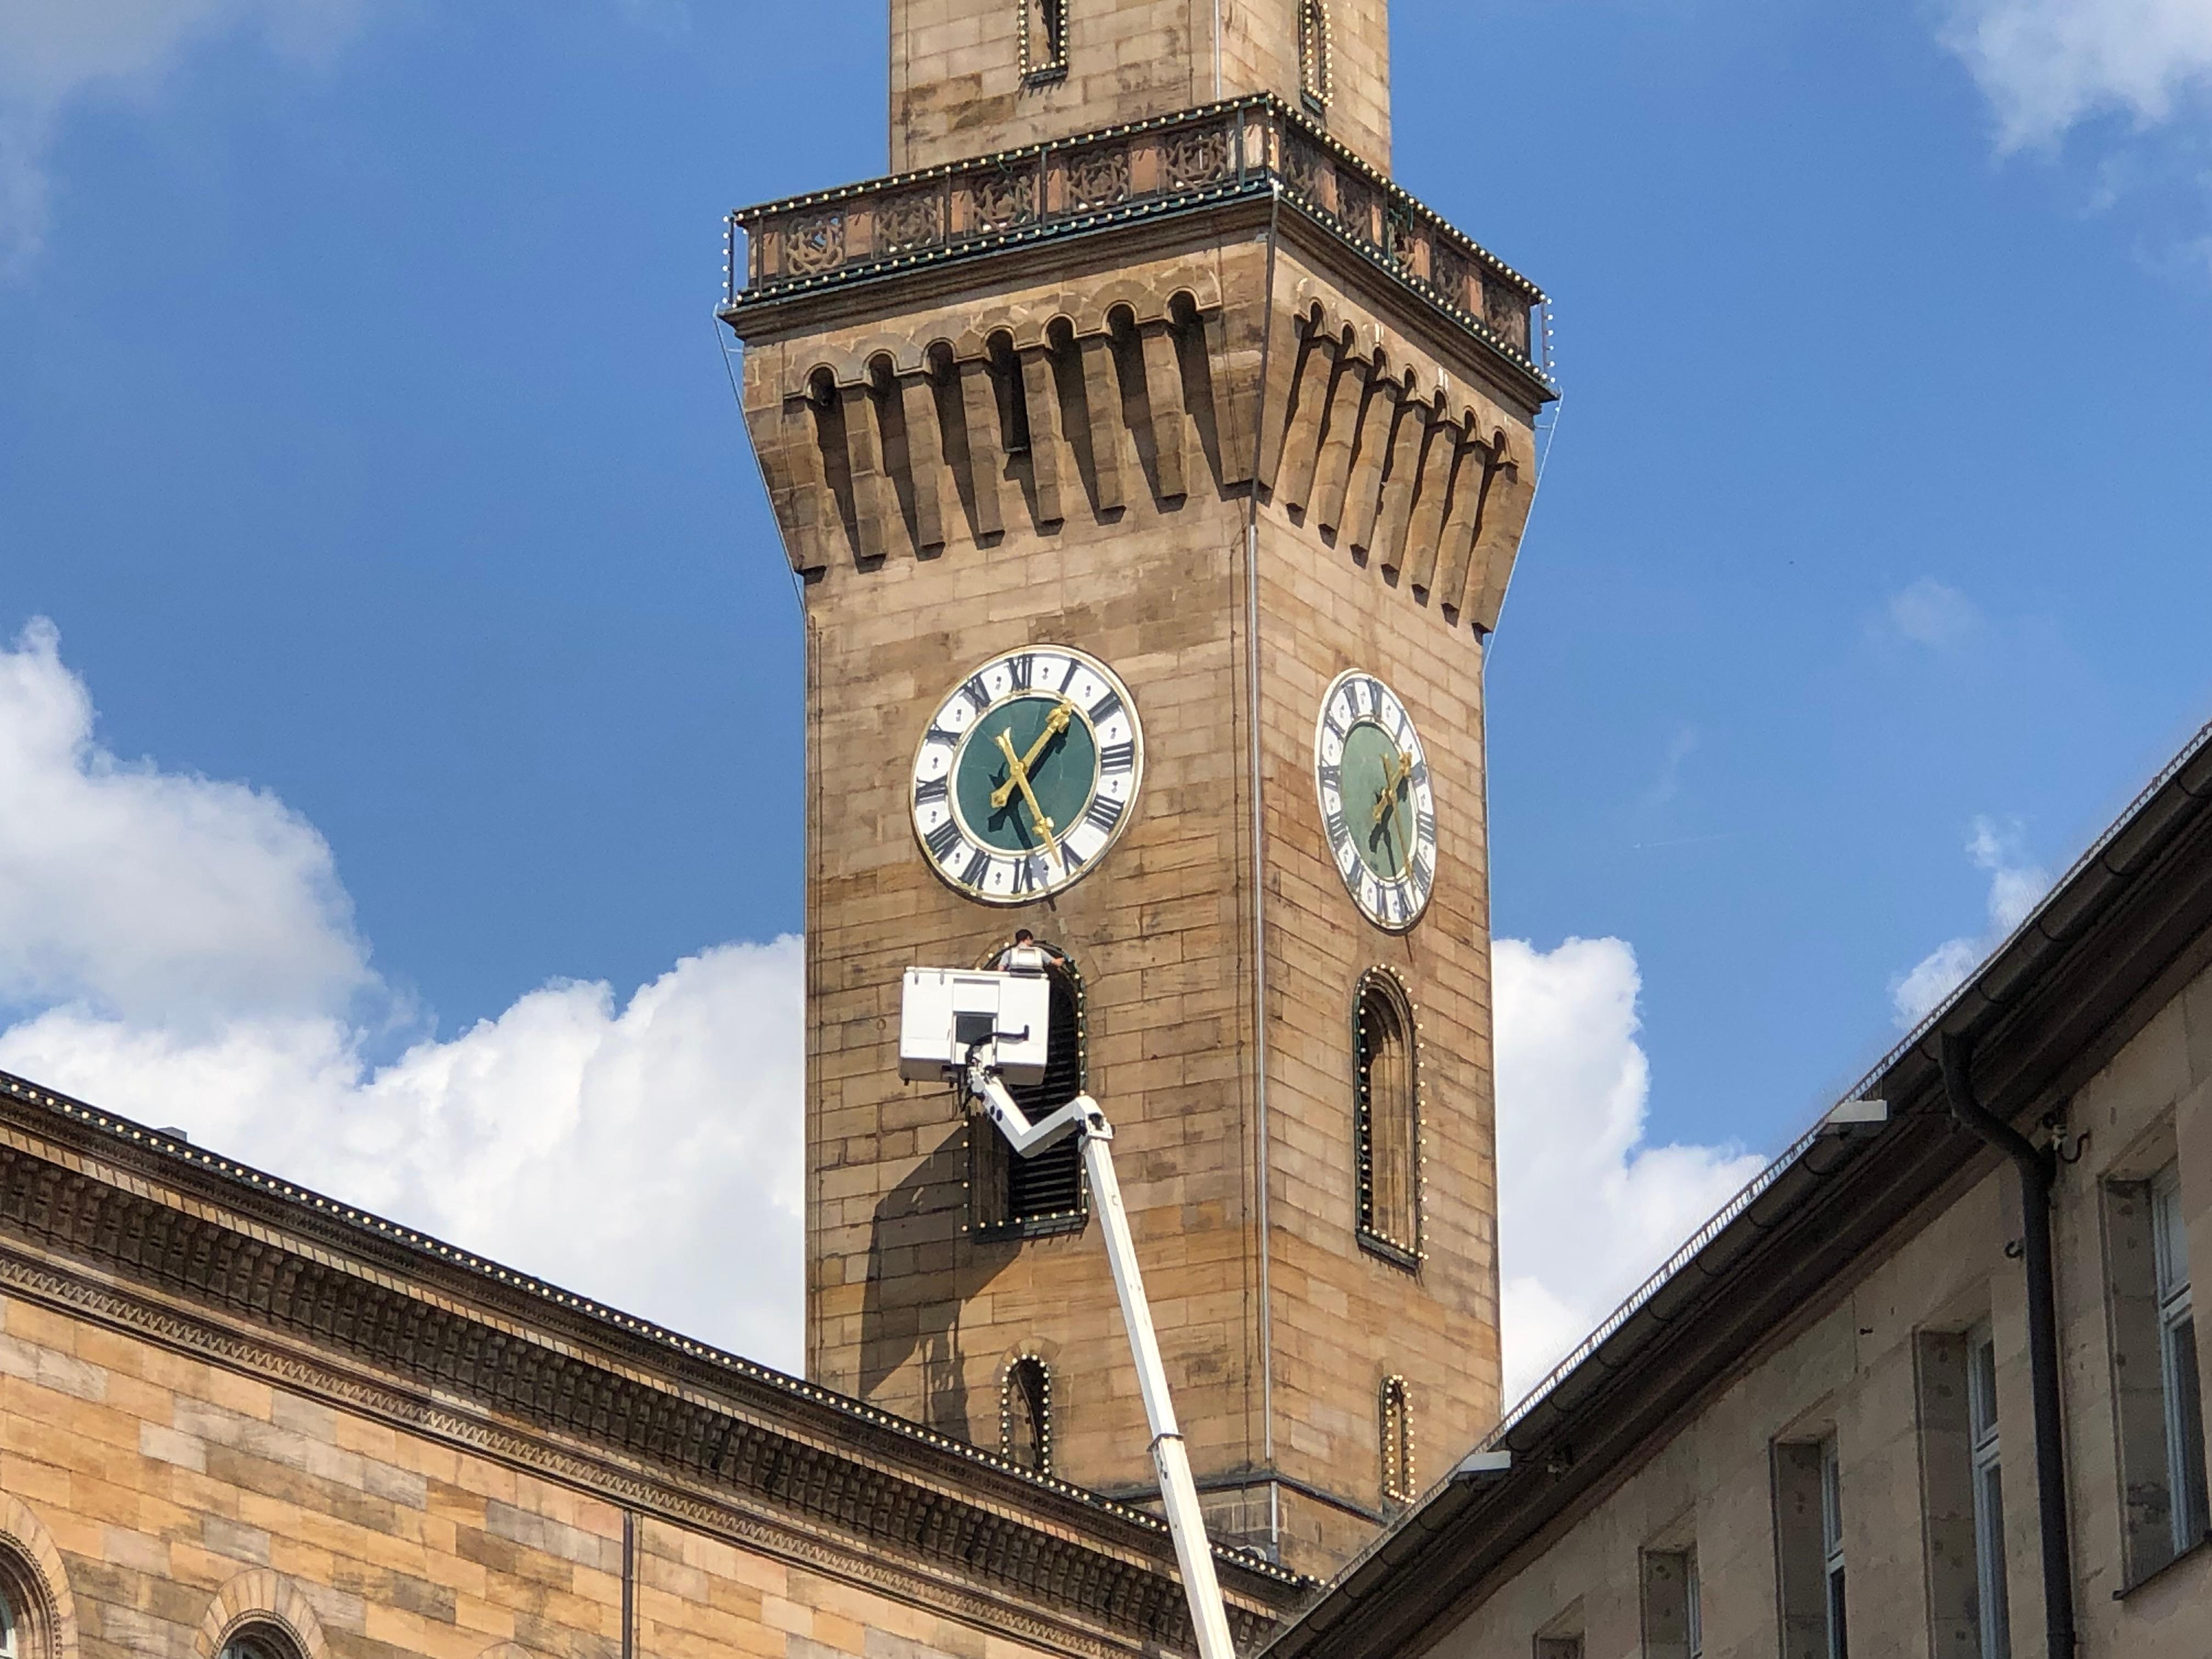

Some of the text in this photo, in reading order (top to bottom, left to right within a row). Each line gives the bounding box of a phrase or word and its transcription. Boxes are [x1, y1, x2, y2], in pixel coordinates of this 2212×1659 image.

[1008, 653, 1035, 692] XII
[1059, 658, 1081, 695] I
[1088, 689, 1120, 726] II
[1101, 741, 1135, 775] III
[915, 777, 947, 804] IX
[1087, 795, 1124, 833] IIII
[958, 850, 991, 890] VII
[1011, 856, 1036, 894] VI
[1061, 839, 1086, 876] V
